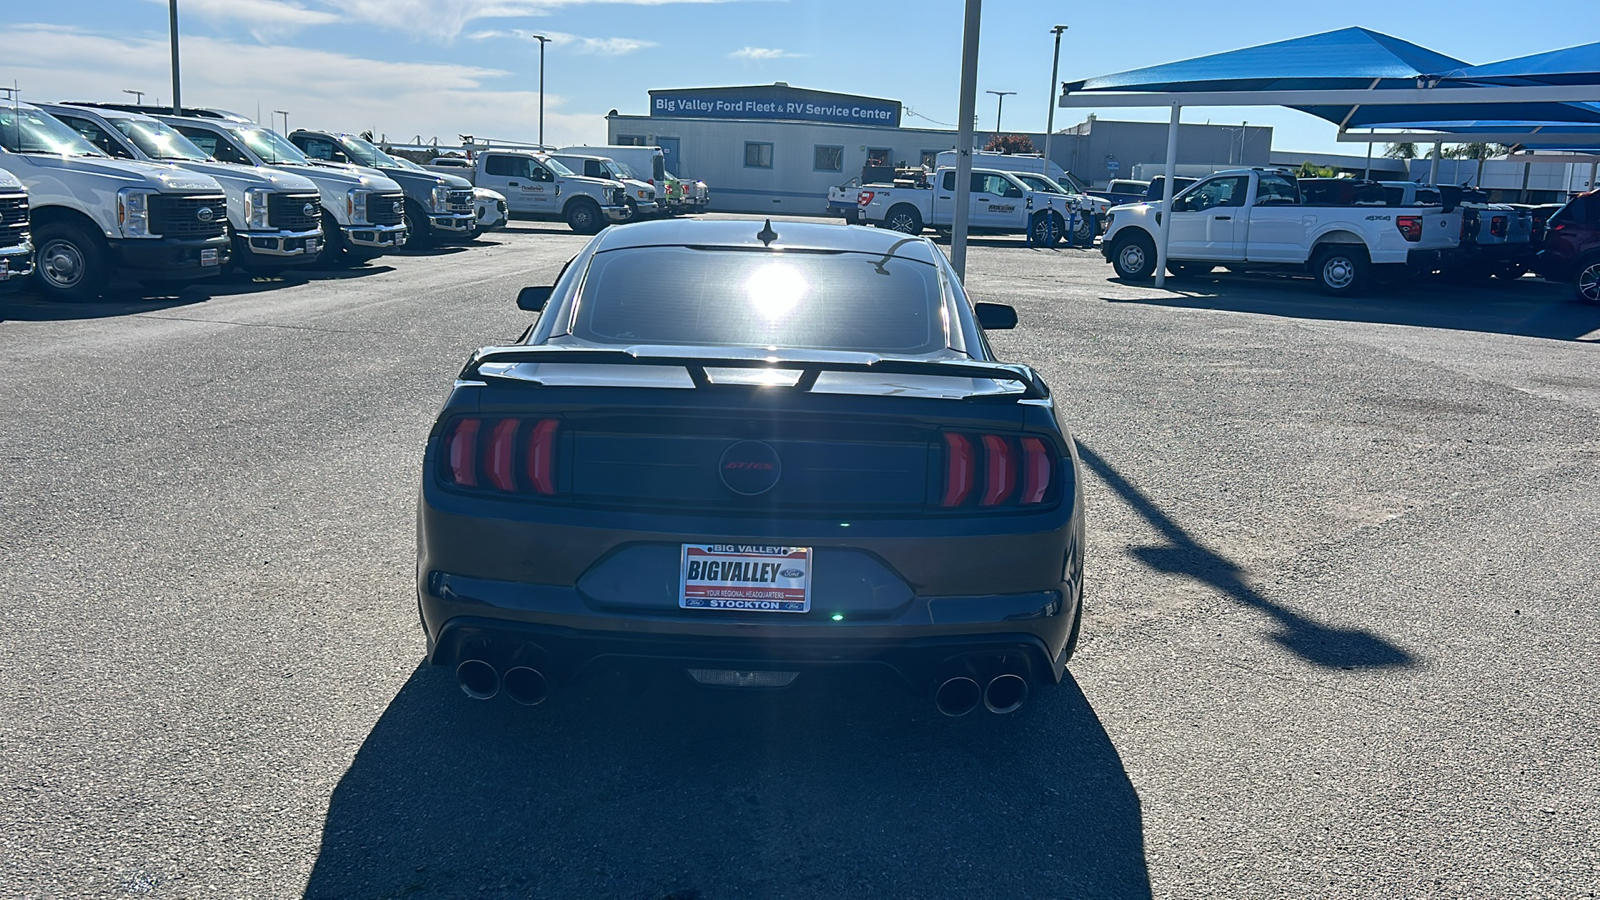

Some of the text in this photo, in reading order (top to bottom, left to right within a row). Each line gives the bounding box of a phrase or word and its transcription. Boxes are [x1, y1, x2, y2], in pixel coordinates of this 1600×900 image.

[656, 99, 892, 119] Big Valley Ford Fleet & RV Service Center
[714, 544, 780, 554] BIG VALLEY
[687, 560, 781, 583] BIGVALLEY
[706, 589, 784, 599] YOUR REGIONAL HEADQUARTERS
[710, 600, 780, 609] STOCKTON
